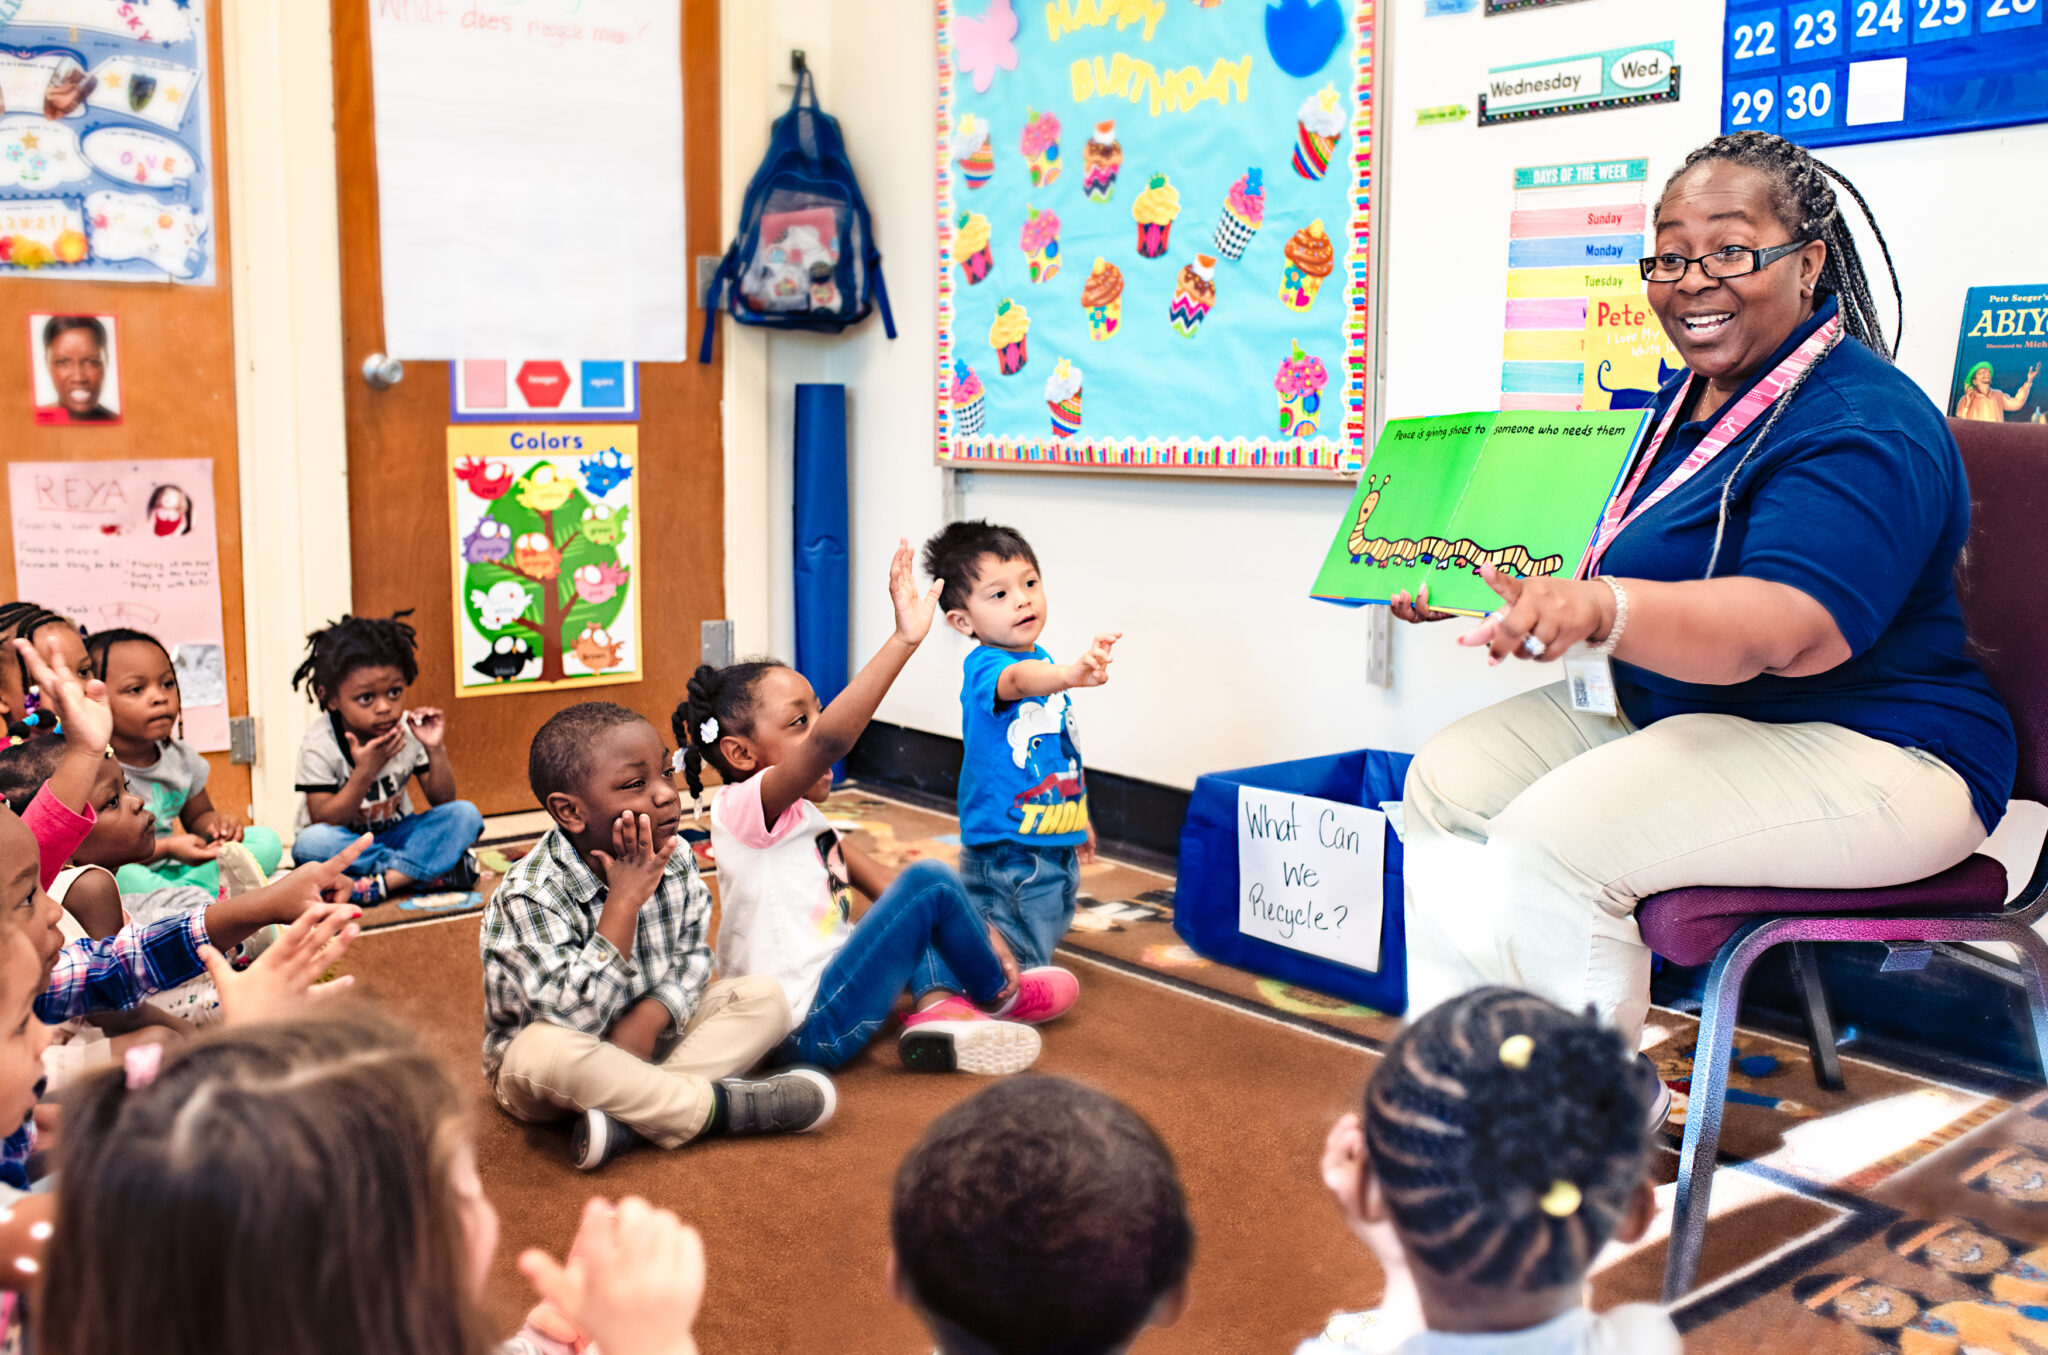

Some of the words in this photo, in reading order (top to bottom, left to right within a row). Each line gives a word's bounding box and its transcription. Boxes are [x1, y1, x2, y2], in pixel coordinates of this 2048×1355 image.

[460, 2, 511, 32] does
[1734, 22, 1775, 59] 22
[1794, 10, 1837, 50] 23
[1856, 0, 1903, 37] 24
[1919, 0, 1967, 29] 25
[1070, 53, 1252, 118] BIRTHDAY
[1490, 73, 1581, 99] Wednesday
[1621, 58, 1663, 80] Wed.
[1732, 88, 1774, 126] 29
[1786, 82, 1831, 120] 30
[1533, 168, 1558, 184] DAYS
[1560, 167, 1574, 183] OF
[1576, 165, 1596, 182] THE
[1599, 164, 1628, 180] WEEK
[1587, 213, 1622, 226] Sunday
[1585, 244, 1623, 258] Monday
[1585, 275, 1623, 289] Tuesday
[1989, 294, 2009, 302] Pete
[1598, 302, 1645, 327] Pete
[1968, 307, 2048, 337] ABIY
[1614, 332, 1637, 345] Love
[1642, 327, 1660, 342] My
[510, 431, 583, 450] Colors
[1394, 429, 1416, 441] Peace
[1417, 428, 1425, 439] is
[1425, 426, 1447, 442] giving
[1448, 425, 1472, 437] shoes
[1475, 424, 1486, 434] to
[1493, 424, 1534, 436] someone
[1538, 424, 1559, 435] who
[1562, 425, 1593, 437] needs
[1597, 425, 1625, 436] them
[34, 474, 127, 508] REYA
[1246, 801, 1301, 842] What
[1319, 809, 1360, 854] Can
[1283, 861, 1320, 888] We
[1249, 883, 1348, 939] Recycle?
